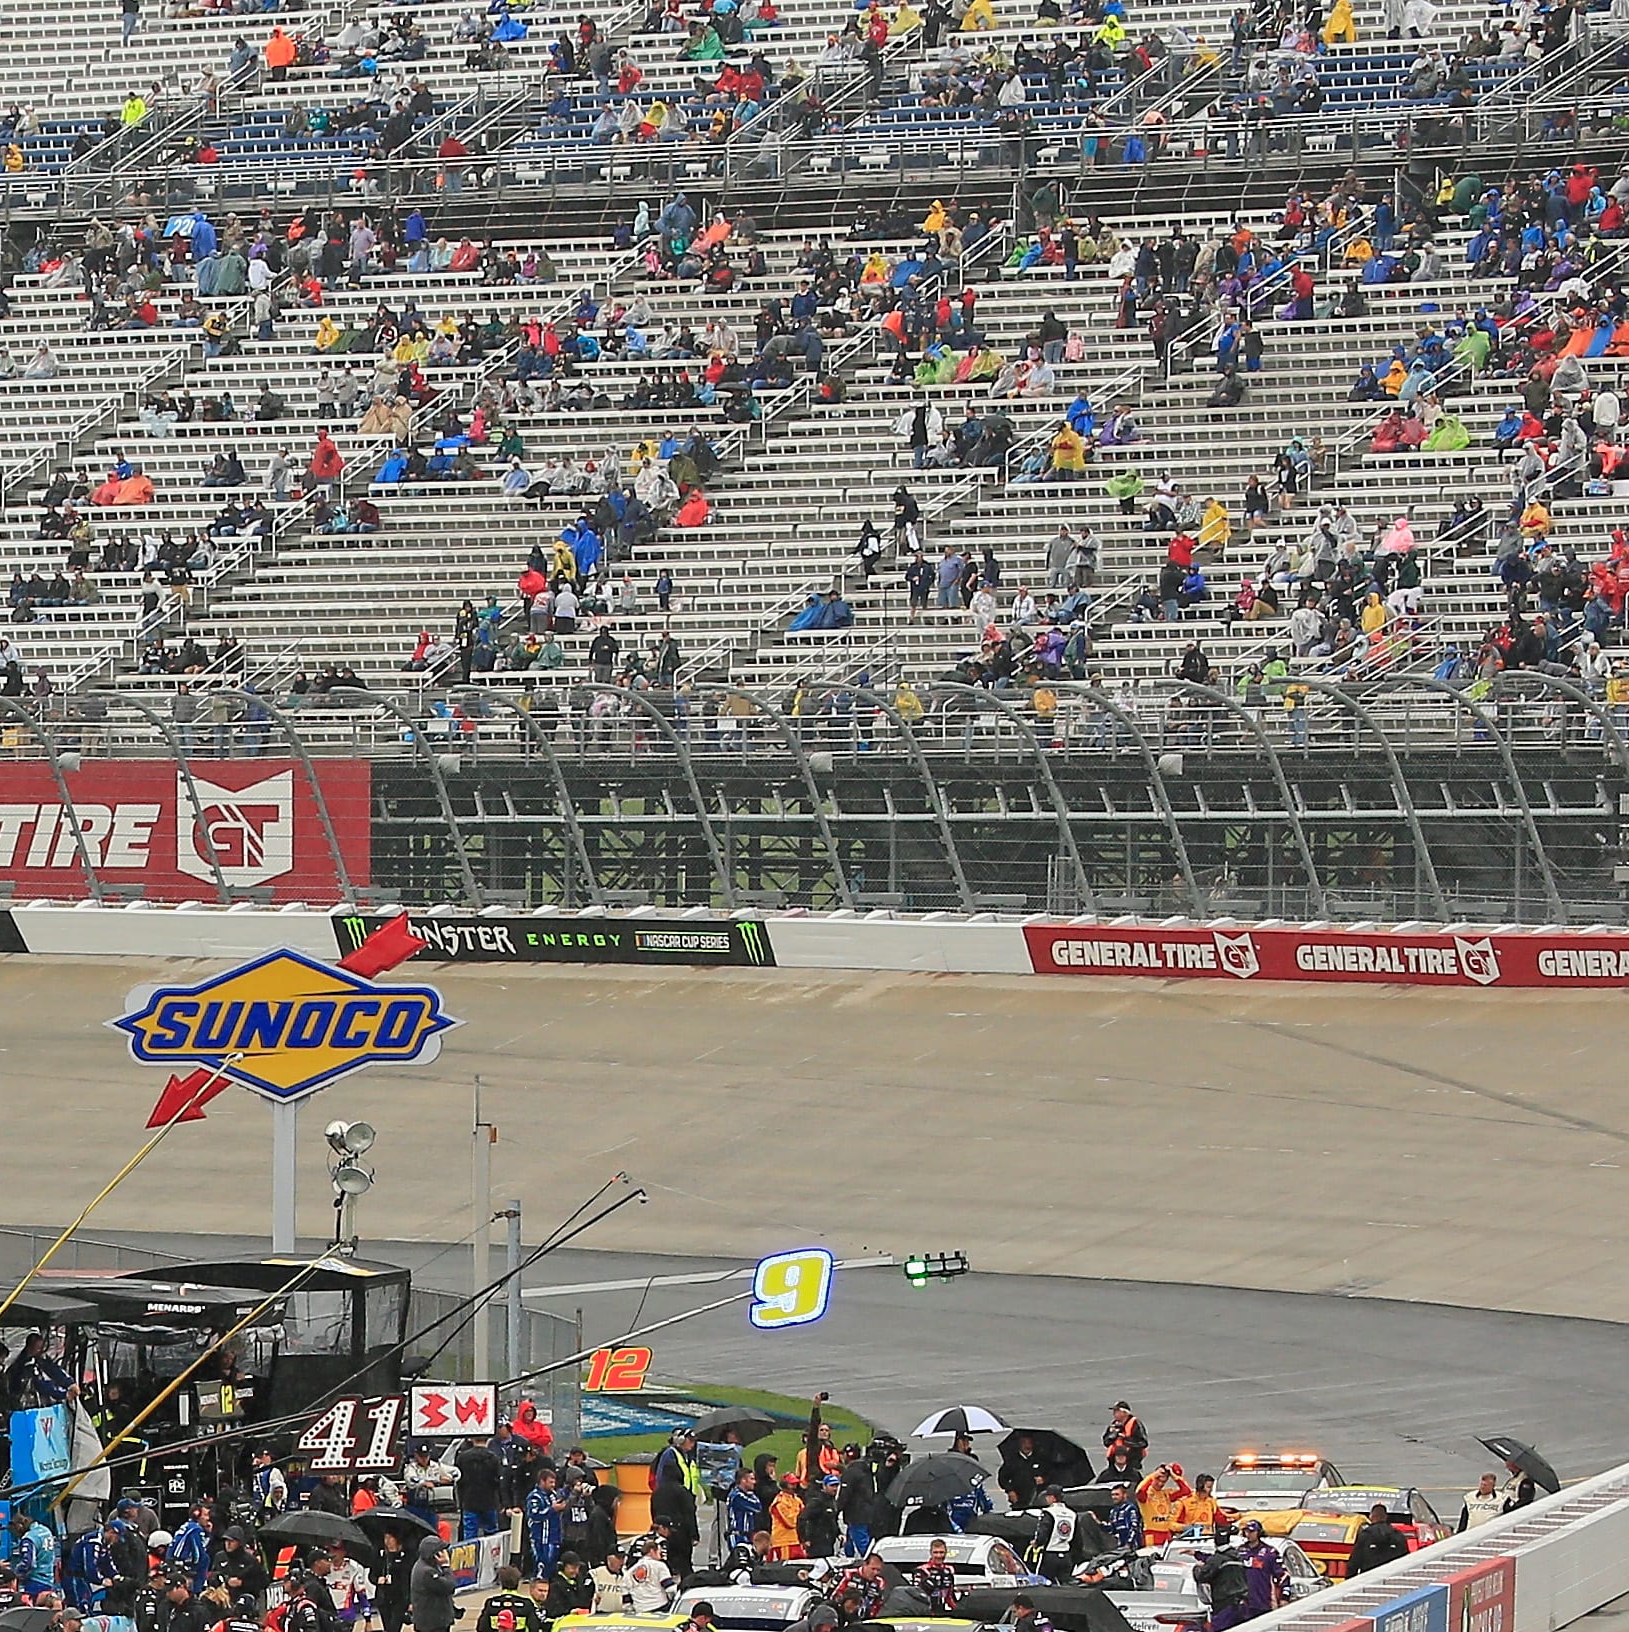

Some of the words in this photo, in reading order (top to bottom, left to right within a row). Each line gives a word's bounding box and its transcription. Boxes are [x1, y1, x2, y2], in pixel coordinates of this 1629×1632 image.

[647, 934, 680, 948] NASCAR
[682, 935, 699, 949] CUP
[700, 936, 730, 950] SERIES
[1052, 941, 1160, 968] GENERAL
[1161, 943, 1217, 970] TIRE
[1296, 945, 1404, 973] GENERAL
[1404, 947, 1457, 976] TIRE
[150, 1000, 423, 1049] SUNOCO
[750, 1248, 833, 1327] 9
[147, 1303, 202, 1315] MENARDS
[586, 1347, 652, 1392] 12
[299, 1398, 402, 1470] 41
